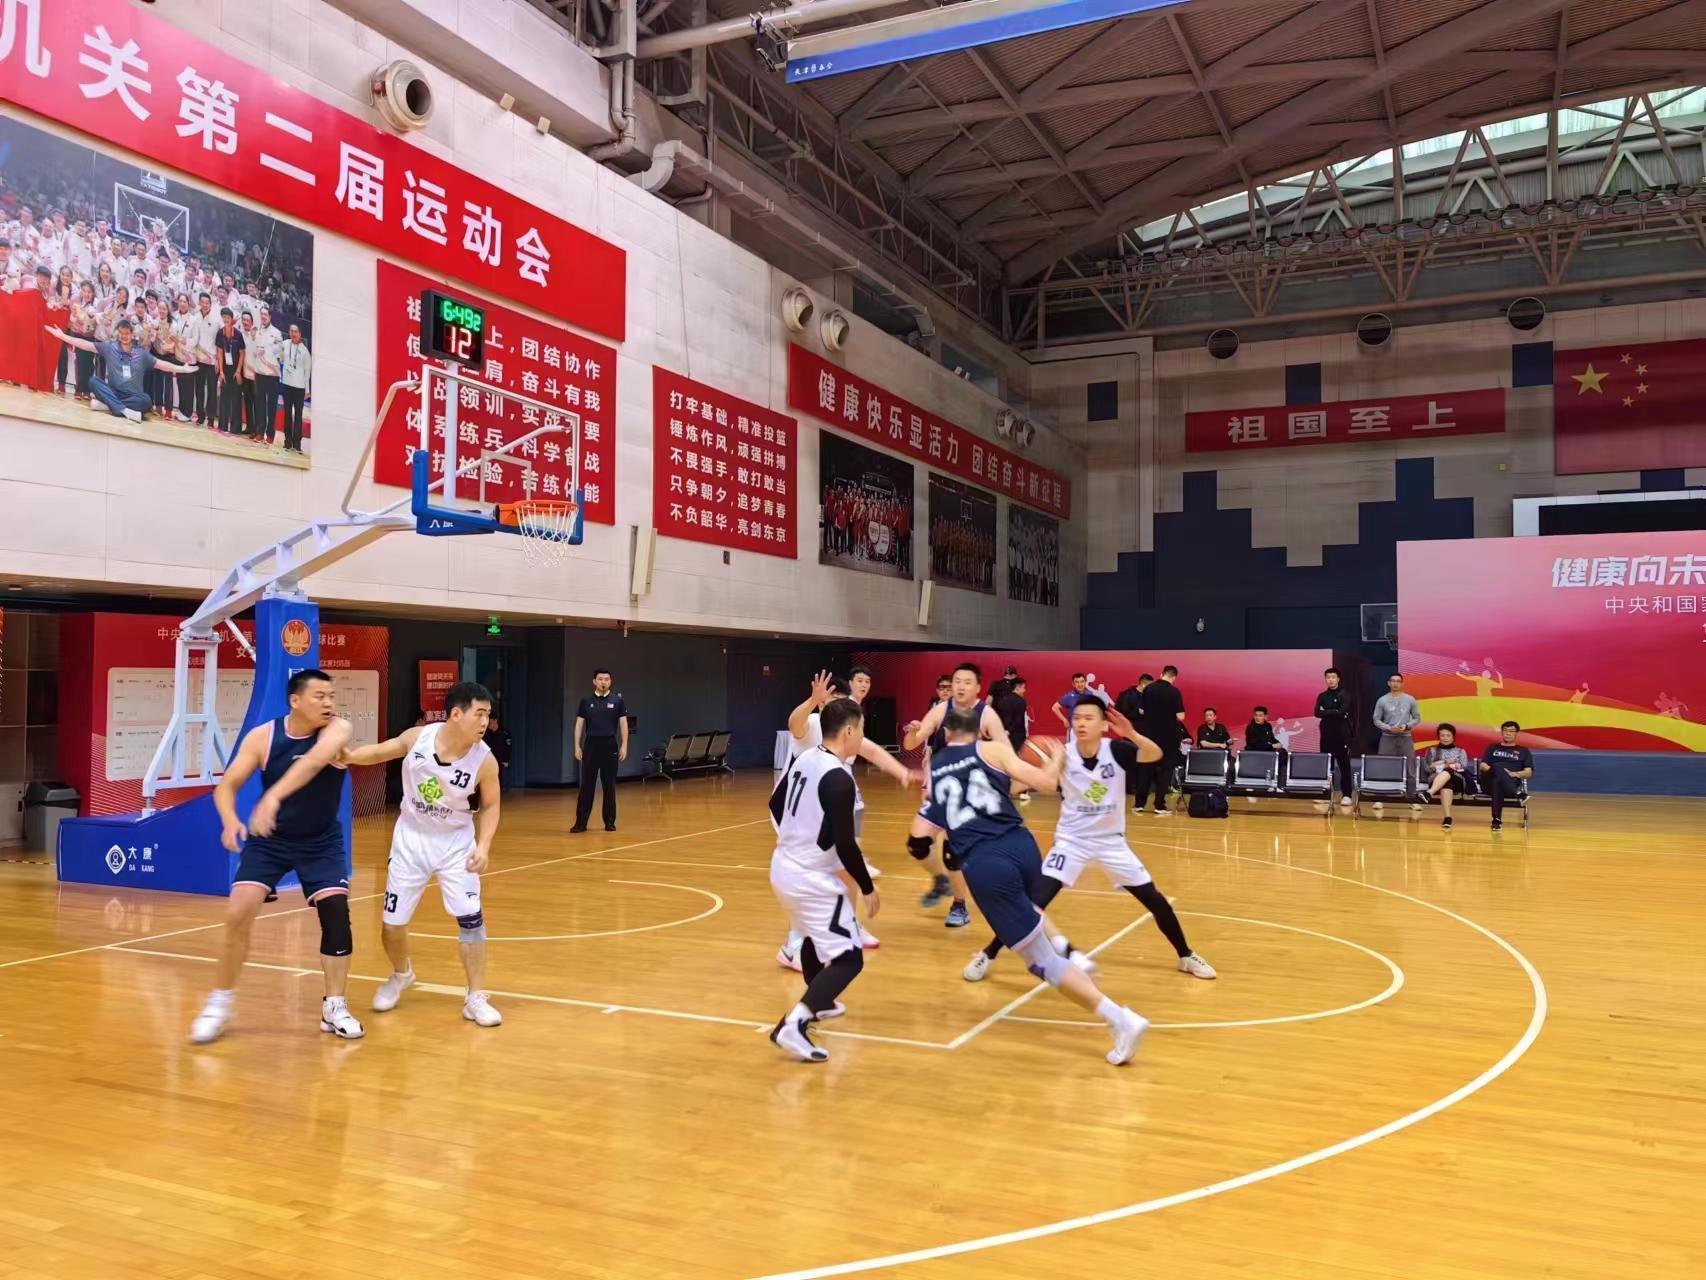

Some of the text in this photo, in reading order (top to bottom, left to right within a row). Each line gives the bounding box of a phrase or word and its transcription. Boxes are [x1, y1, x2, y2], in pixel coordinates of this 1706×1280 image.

[406, 295, 600, 380] 祖上，团结协作
[450, 326, 472, 359] 12
[406, 333, 600, 412] 使肩，奋斗有我
[669, 390, 787, 447] 打牢基础，精准投篮
[818, 368, 1062, 509] 健康快乐显活力 团结奋斗新征程
[1227, 401, 1457, 444] 祖国至上
[669, 417, 787, 471] 锤炼作风，顽强拼搏
[669, 446, 787, 495] 不畏强手，敢打敢当
[669, 474, 787, 519] 只争朝夕，追梦青春
[669, 502, 787, 543] 不负韶华，亮剑东京
[450, 769, 471, 789] 33
[788, 771, 807, 817] 11
[1100, 763, 1115, 779] 20
[935, 768, 1001, 830] 24
[1046, 853, 1066, 871] 20
